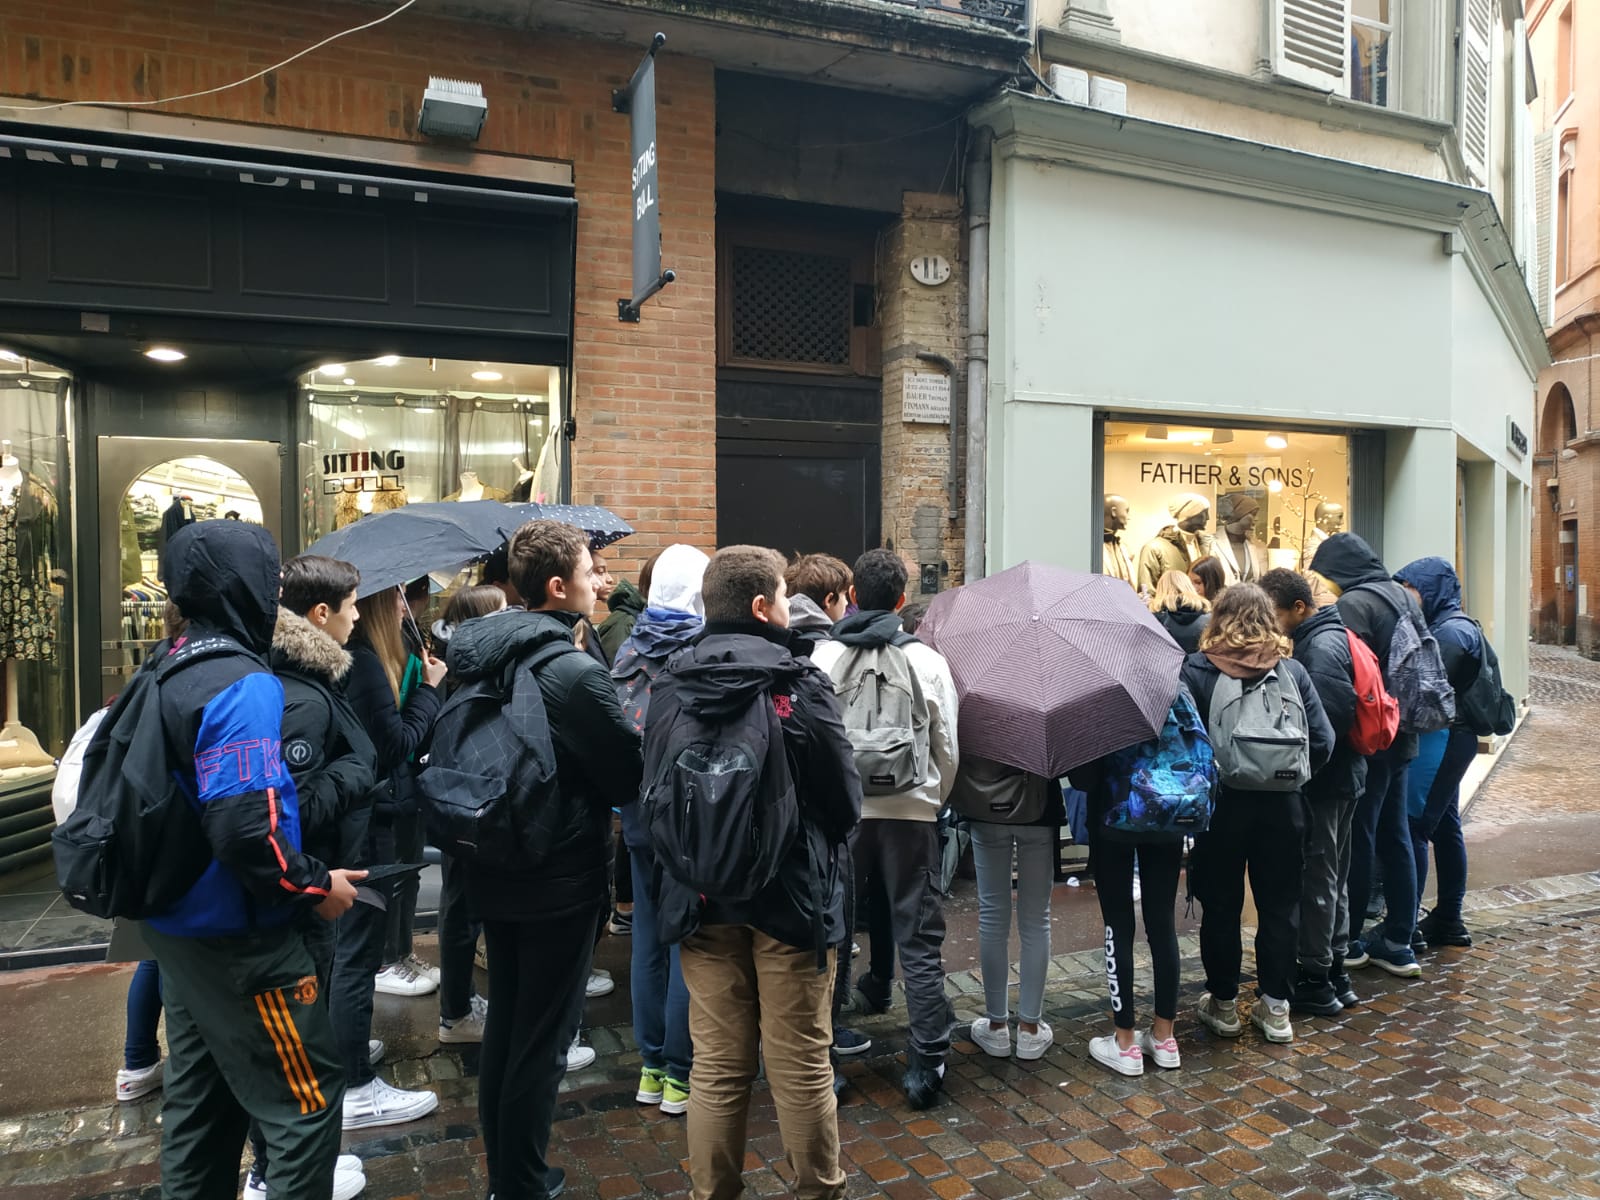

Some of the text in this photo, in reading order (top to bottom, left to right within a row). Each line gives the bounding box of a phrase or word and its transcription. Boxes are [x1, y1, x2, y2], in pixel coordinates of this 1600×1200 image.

[323, 449, 405, 475] SITTING
[1141, 462, 1303, 488] FATHER & SONS
[323, 475, 405, 495] BULL
[1105, 925, 1122, 1012] adidas
